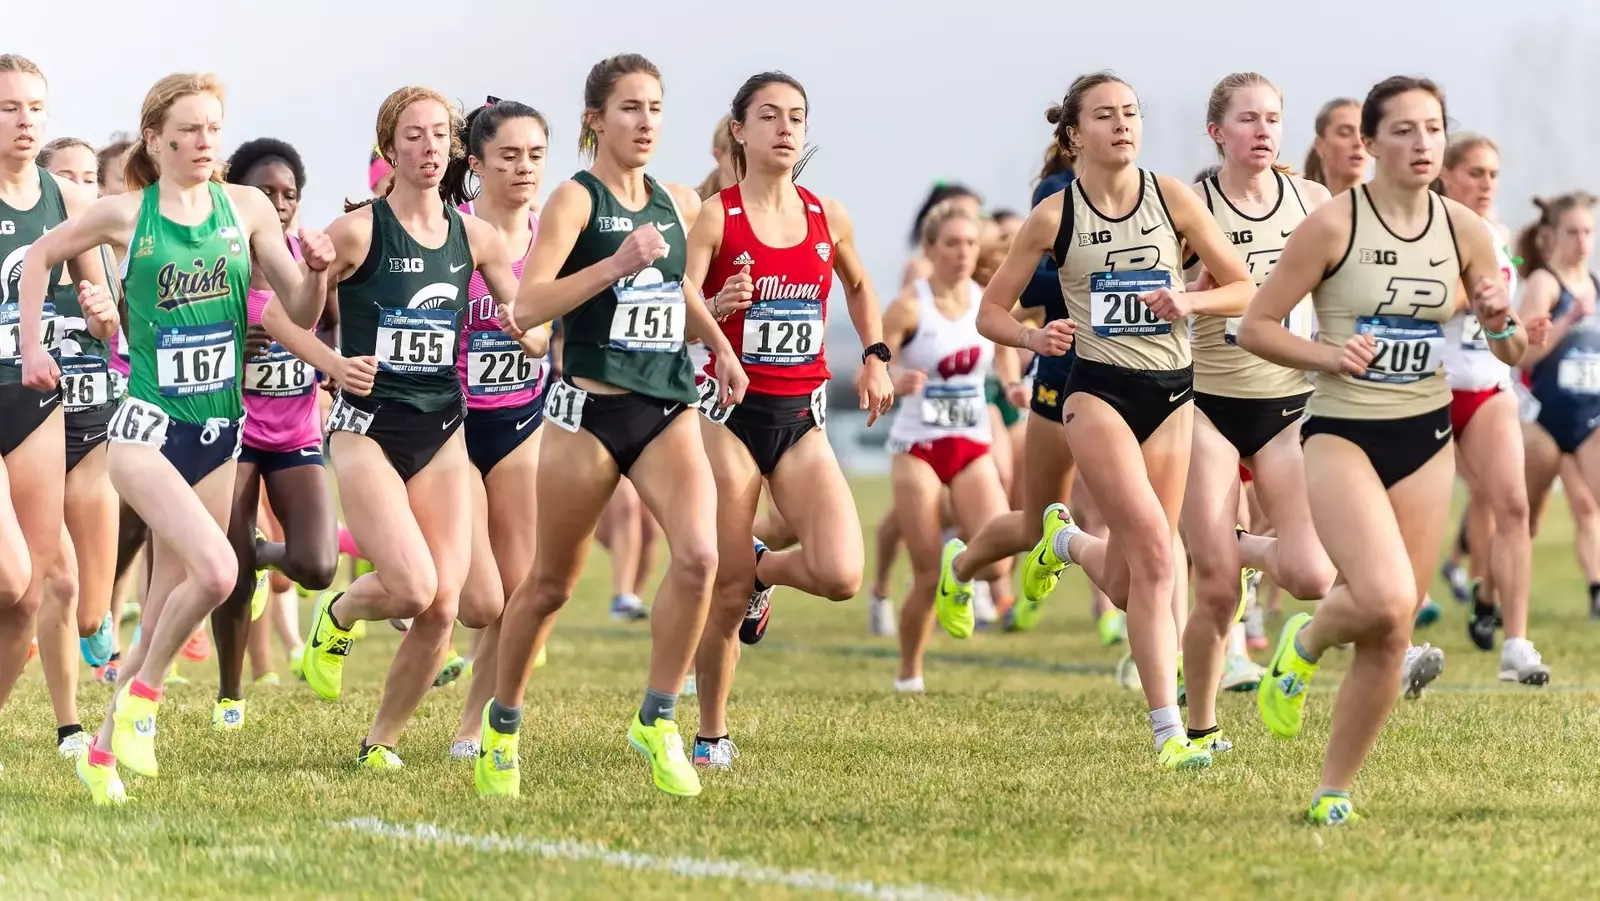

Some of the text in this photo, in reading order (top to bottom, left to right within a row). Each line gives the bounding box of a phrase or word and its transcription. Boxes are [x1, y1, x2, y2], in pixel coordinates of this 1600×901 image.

[157, 256, 231, 299] Irish
[755, 274, 824, 300] Miami
[1374, 277, 1447, 317] P
[10, 320, 55, 356] 14
[624, 306, 673, 339] 151
[757, 322, 812, 353] 128
[389, 330, 444, 364] 155
[1367, 340, 1431, 372] 209
[172, 345, 227, 383] 167
[256, 360, 305, 389] 218
[479, 352, 531, 383] 226
[1037, 385, 1058, 407] M
[109, 401, 165, 442] 167
